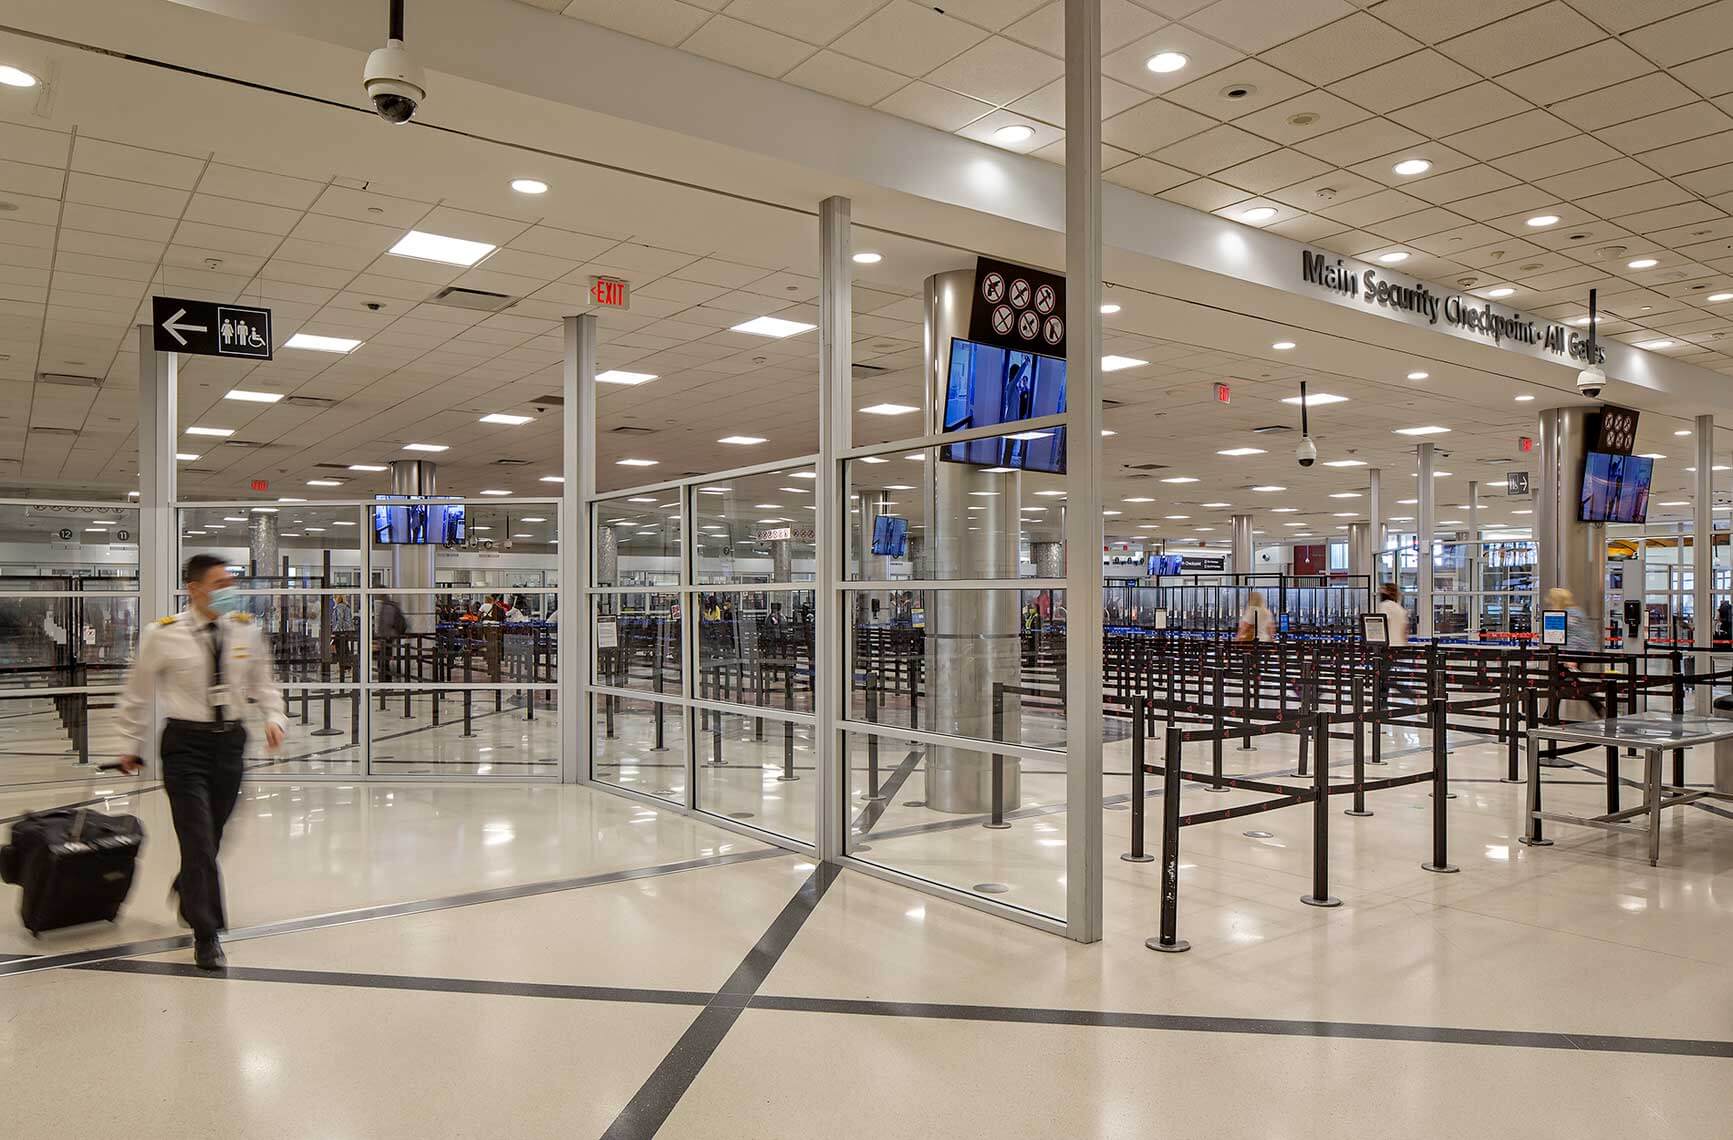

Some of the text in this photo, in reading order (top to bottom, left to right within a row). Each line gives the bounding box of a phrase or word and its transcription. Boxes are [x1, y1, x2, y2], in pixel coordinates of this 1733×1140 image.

[597, 279, 625, 306] EXIT
[1302, 250, 1359, 297] Main
[1363, 269, 1440, 325] Security
[1444, 295, 1537, 344] Checkpoint
[1545, 324, 1565, 355] All
